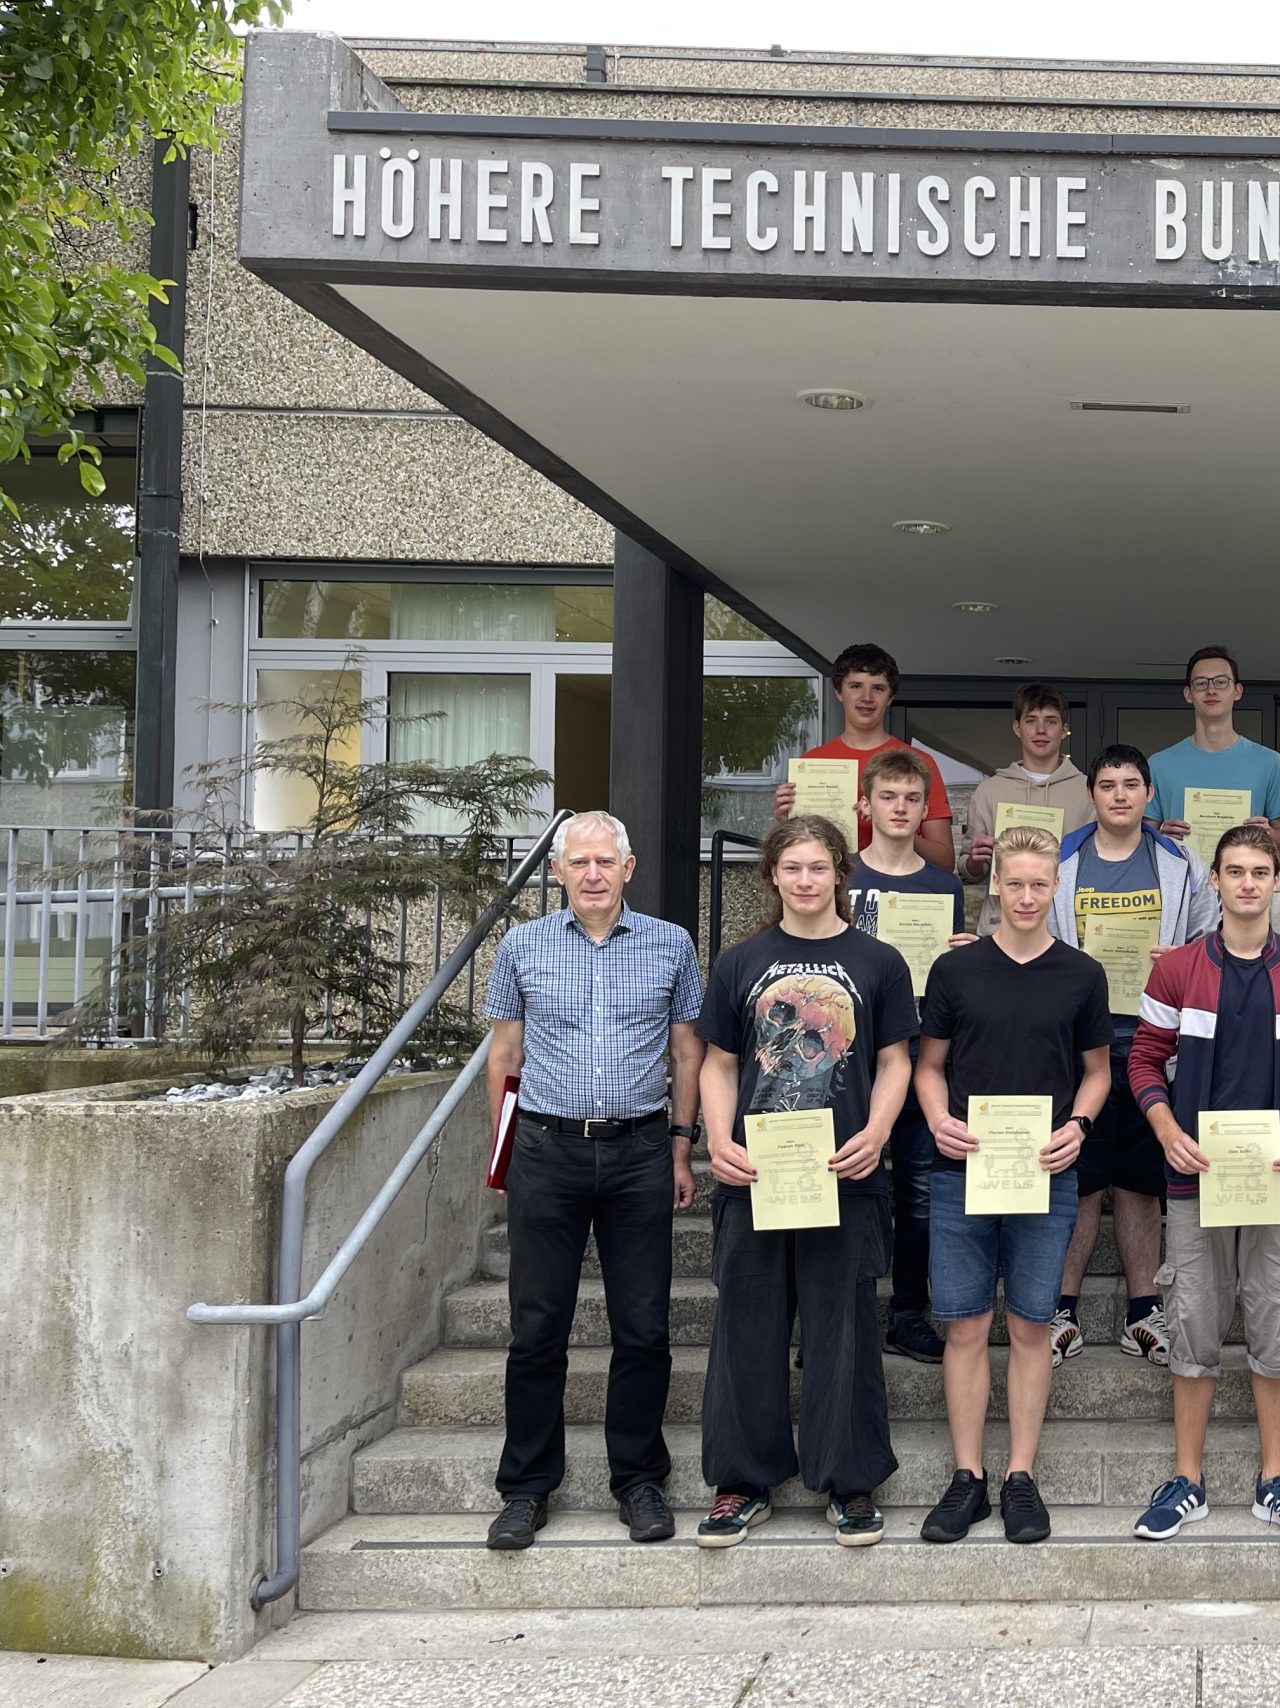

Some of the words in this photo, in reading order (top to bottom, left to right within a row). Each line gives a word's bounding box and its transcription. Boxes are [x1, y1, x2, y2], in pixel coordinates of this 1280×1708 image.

[332, 147, 600, 245] HÖHERE
[661, 166, 1088, 259] TECHNISCHE
[1080, 894, 1155, 910] FREEDOM
[746, 960, 863, 1007] METALLICA
